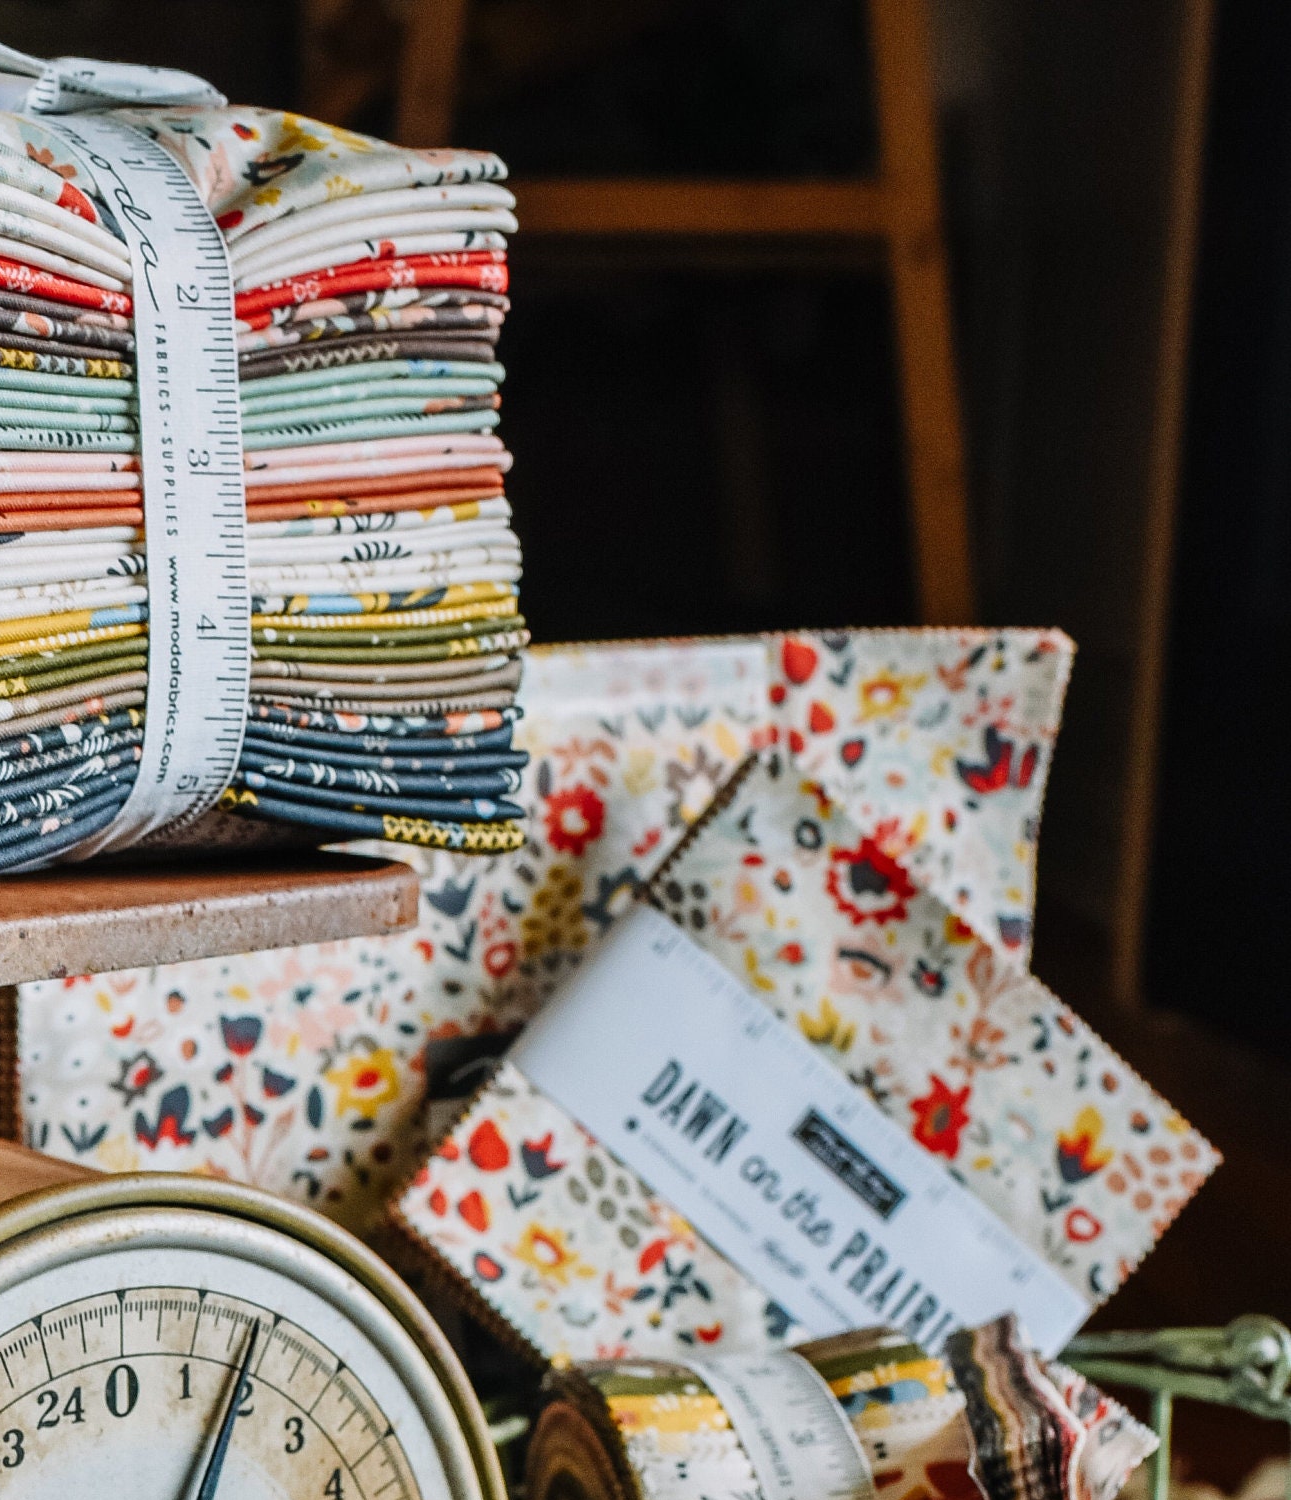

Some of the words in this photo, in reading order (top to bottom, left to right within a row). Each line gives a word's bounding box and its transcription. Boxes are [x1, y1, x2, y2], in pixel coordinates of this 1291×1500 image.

[177, 284, 199, 304] 2
[154, 324, 171, 412] FABRICS
[187, 449, 210, 468] 3
[160, 436, 179, 538] SUPPLIES
[155, 555, 181, 785] www.modafabrics.com
[639, 1057, 751, 1166] DAWN
[828, 1228, 954, 1348] PRAIRI
[105, 1363, 140, 1418] 0
[178, 1363, 193, 1400] 1
[36, 1386, 86, 1430] 24
[283, 1416, 305, 1455] 3
